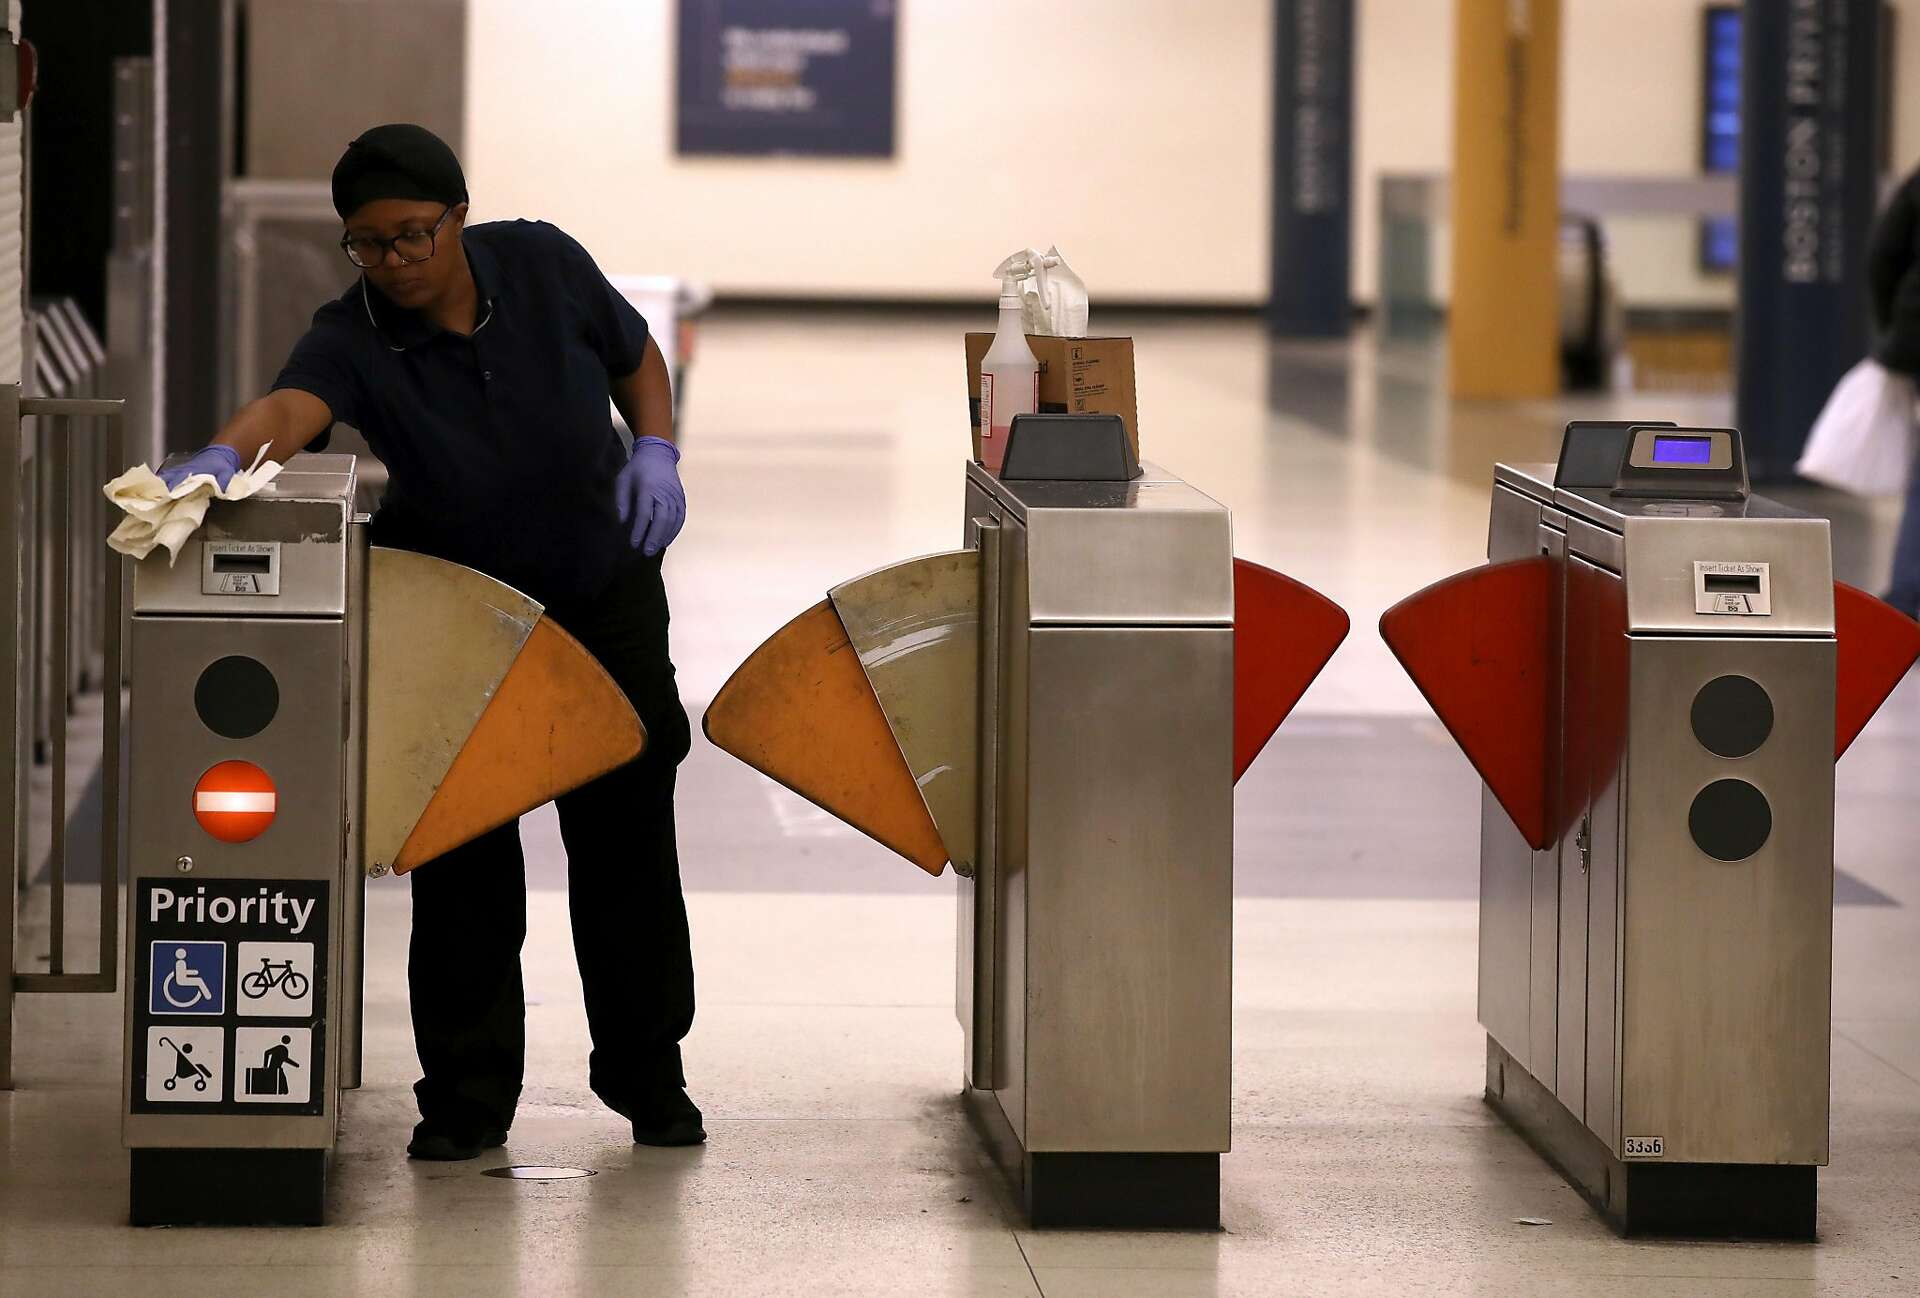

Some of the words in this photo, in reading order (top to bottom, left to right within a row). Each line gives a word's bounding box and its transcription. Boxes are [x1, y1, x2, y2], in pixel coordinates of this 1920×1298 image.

[1782, 116, 1820, 283] BOSTON
[1699, 563, 1717, 571] Insert
[1718, 564, 1736, 572] Ticket
[1737, 564, 1745, 573] As
[150, 886, 316, 934] Priority
